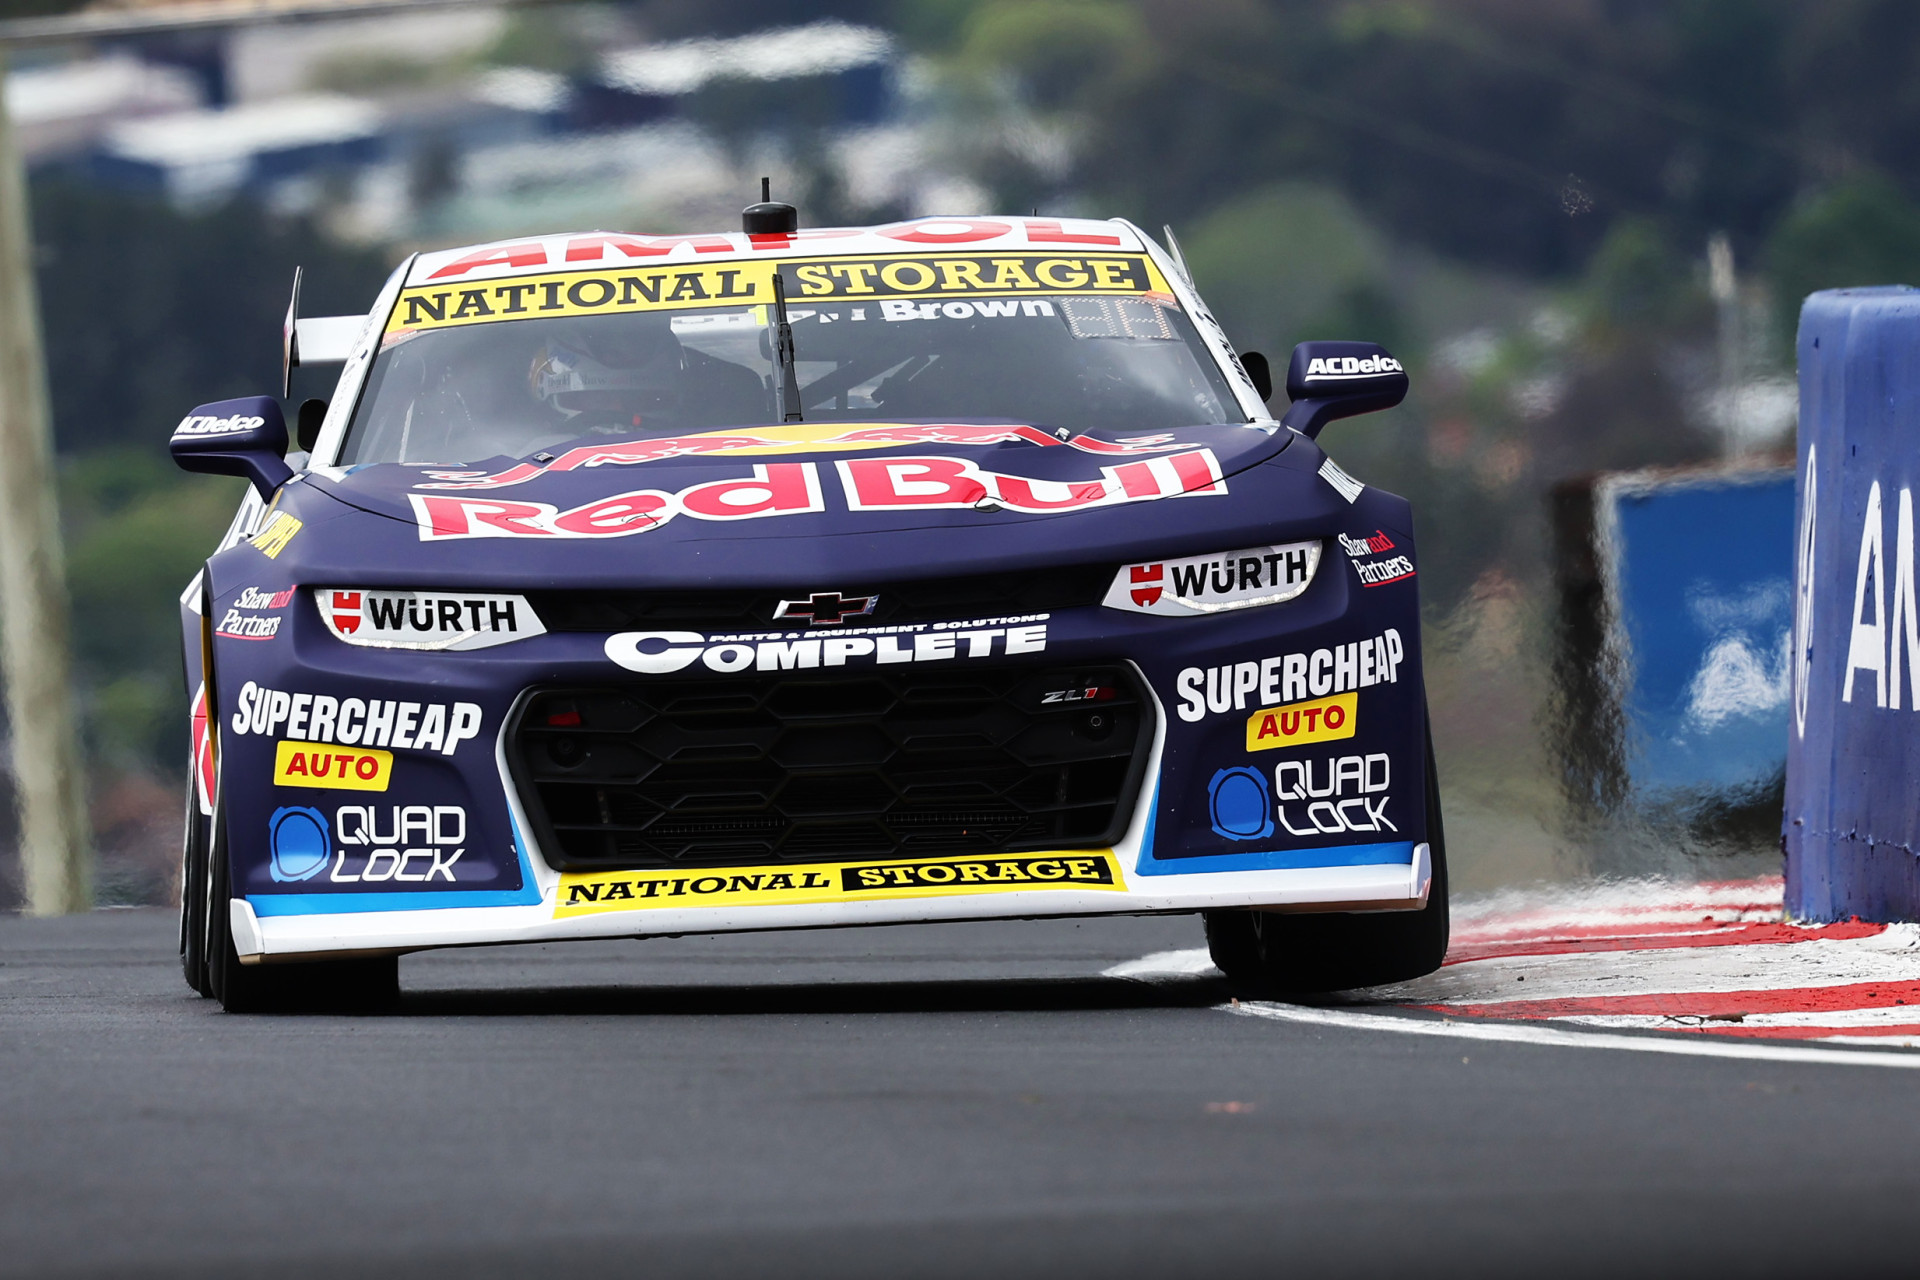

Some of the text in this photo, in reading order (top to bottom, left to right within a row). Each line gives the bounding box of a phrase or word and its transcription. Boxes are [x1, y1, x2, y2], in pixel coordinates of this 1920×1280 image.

[403, 270, 756, 324] NATIONAL
[796, 259, 1135, 296] STORAGE
[879, 298, 1055, 322] Brown
[1306, 354, 1404, 375] ACDelco
[407, 461, 823, 541] Red
[834, 447, 1229, 514] Bull
[1171, 548, 1308, 598] WÜRTH
[1352, 553, 1415, 585] Partners
[216, 609, 282, 637] Partners
[368, 598, 518, 633] WÜRTH
[709, 613, 1051, 643] PARTS & EQUIPMENT SOLUTIONS
[603, 623, 1047, 674] COMPLETE
[1176, 628, 1404, 723] SUPERCHEAP
[1041, 687, 1098, 704] ZL1
[231, 680, 483, 756] SUPERCHEAP
[1256, 704, 1346, 740] AUTO
[285, 752, 379, 781] AUTO
[1275, 752, 1391, 801] QUAD
[336, 805, 467, 846] QUAD
[1277, 796, 1399, 836] LOCK
[330, 847, 467, 883] LOCK
[566, 858, 1101, 906] NATIONAL STORAGE
